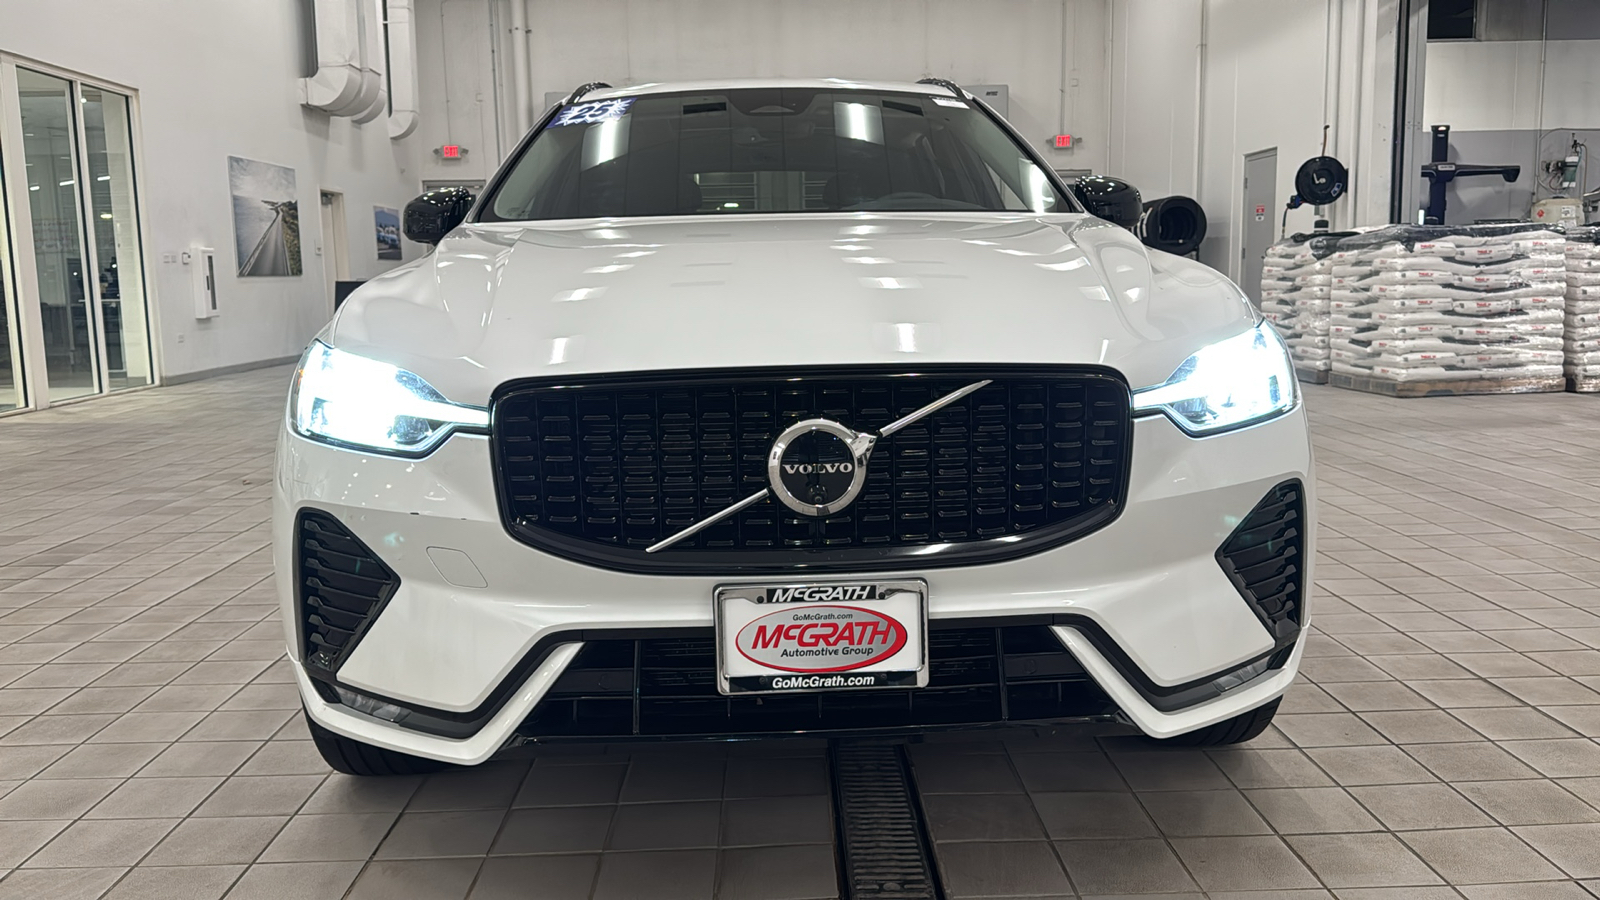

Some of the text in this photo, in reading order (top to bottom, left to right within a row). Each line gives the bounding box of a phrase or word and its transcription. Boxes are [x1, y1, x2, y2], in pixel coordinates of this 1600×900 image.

[568, 104, 614, 120] 25
[782, 462, 853, 475] VOLVO
[792, 613, 853, 621] GoMcGrath.com
[780, 646, 874, 658] Automotive Group
[772, 675, 875, 689] GoMcGrath.com
